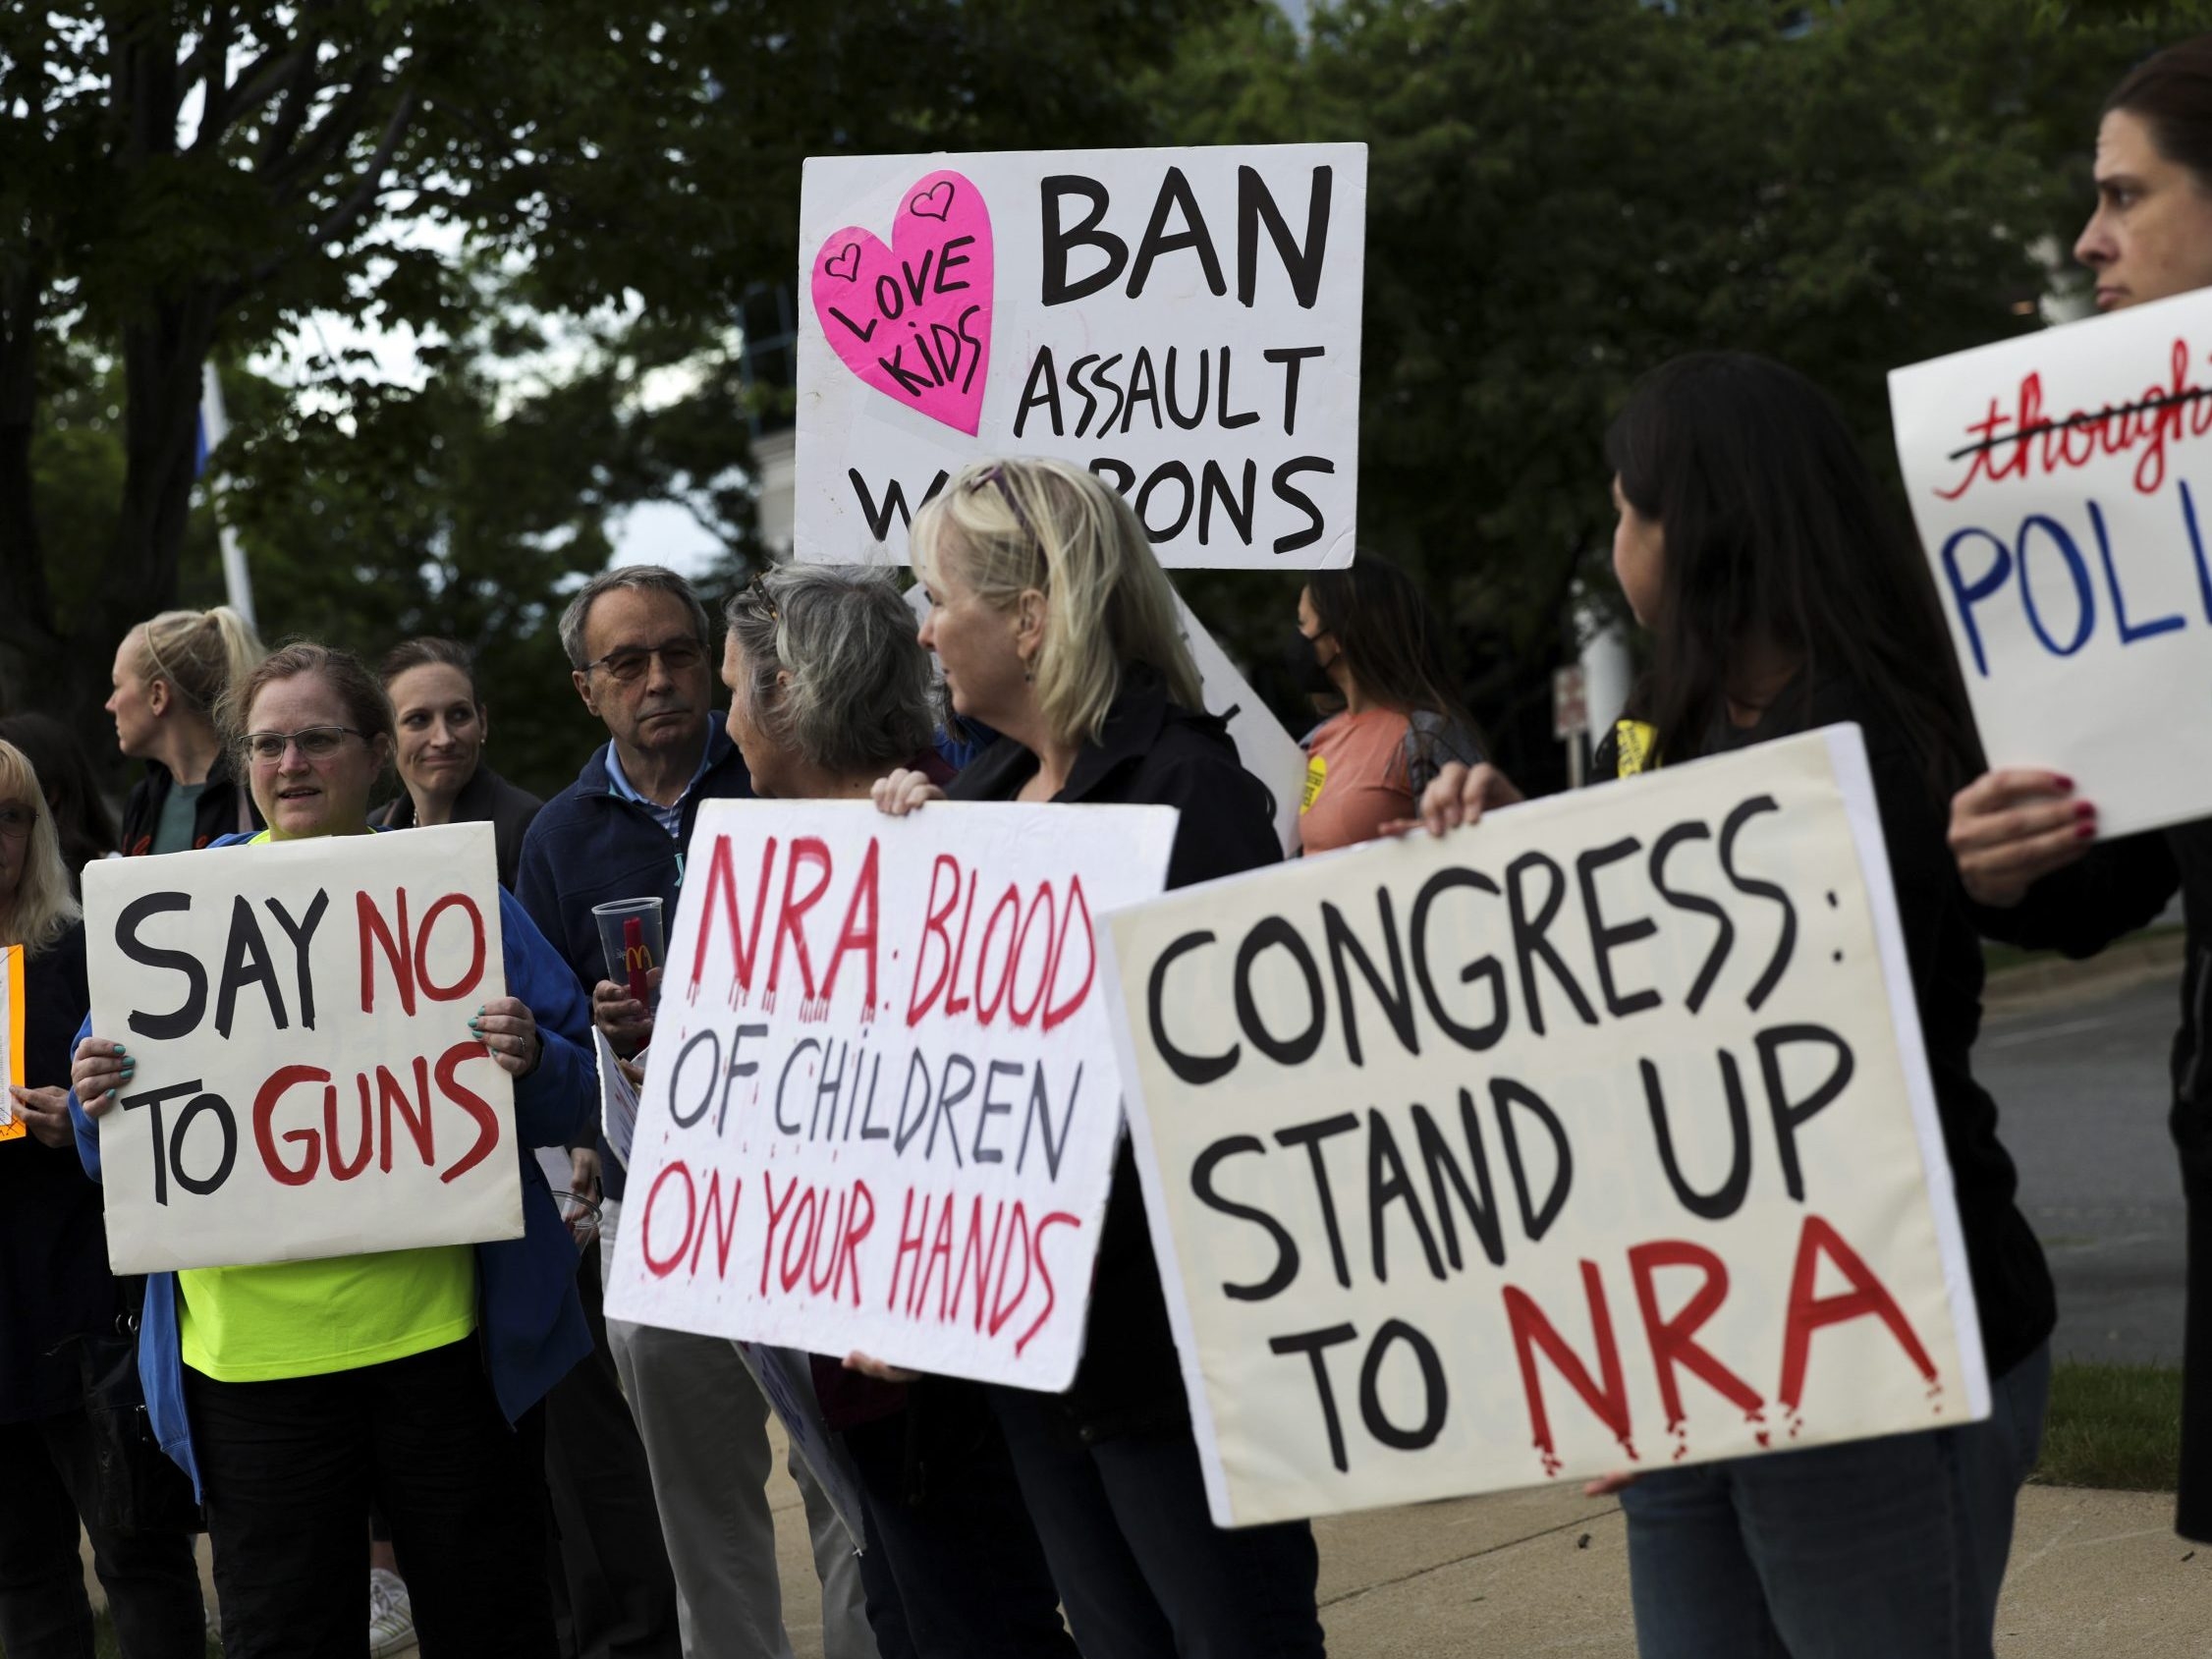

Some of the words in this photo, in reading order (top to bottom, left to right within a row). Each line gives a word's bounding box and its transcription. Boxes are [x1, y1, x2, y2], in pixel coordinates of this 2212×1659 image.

[828, 235, 976, 342] LOVE
[1041, 165, 1333, 308] BAN
[1013, 344, 1325, 439] ASSAULT
[1931, 337, 2212, 501] though
[848, 456, 1335, 555] WONS
[115, 887, 329, 1041] SAY
[356, 886, 487, 1018] NO
[906, 854, 1096, 1034] BLOOD
[121, 1078, 238, 1206] TO
[252, 1041, 500, 1187] GUNS
[668, 1023, 768, 1138] OF
[1190, 1077, 1574, 1302] STAND
[1639, 1023, 1855, 1221] UP
[641, 1160, 742, 1281] ON
[759, 1170, 875, 1308] YOUR
[887, 1185, 1080, 1358] HANDS
[1268, 1318, 1448, 1474] TO
[1502, 1213, 1943, 1468] NRA
